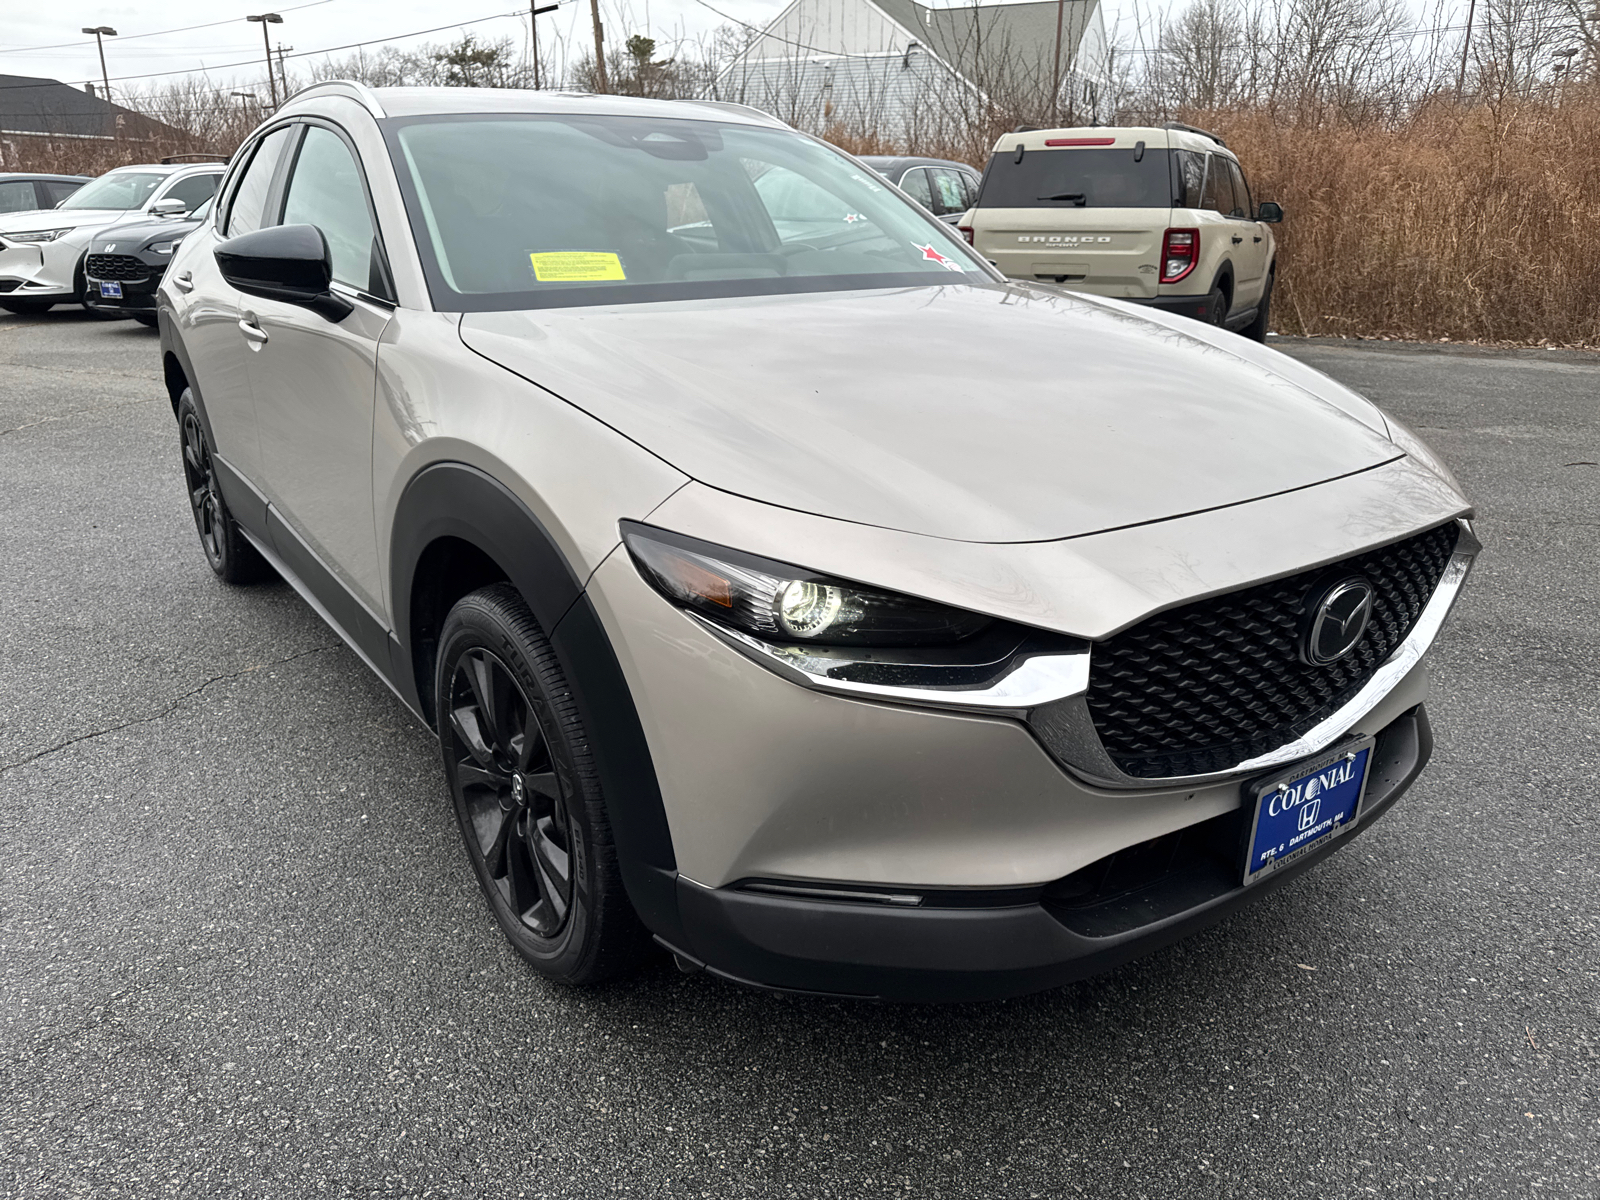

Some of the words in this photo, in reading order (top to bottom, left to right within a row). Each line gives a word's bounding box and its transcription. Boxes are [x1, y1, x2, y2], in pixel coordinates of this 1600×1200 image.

[1268, 762, 1355, 817] COLONIAL
[1260, 847, 1277, 861] RTE.
[1279, 843, 1285, 852] 6
[1334, 811, 1344, 823] MA
[1273, 848, 1307, 870] COLONIAL
[1309, 834, 1333, 852] HONDA
